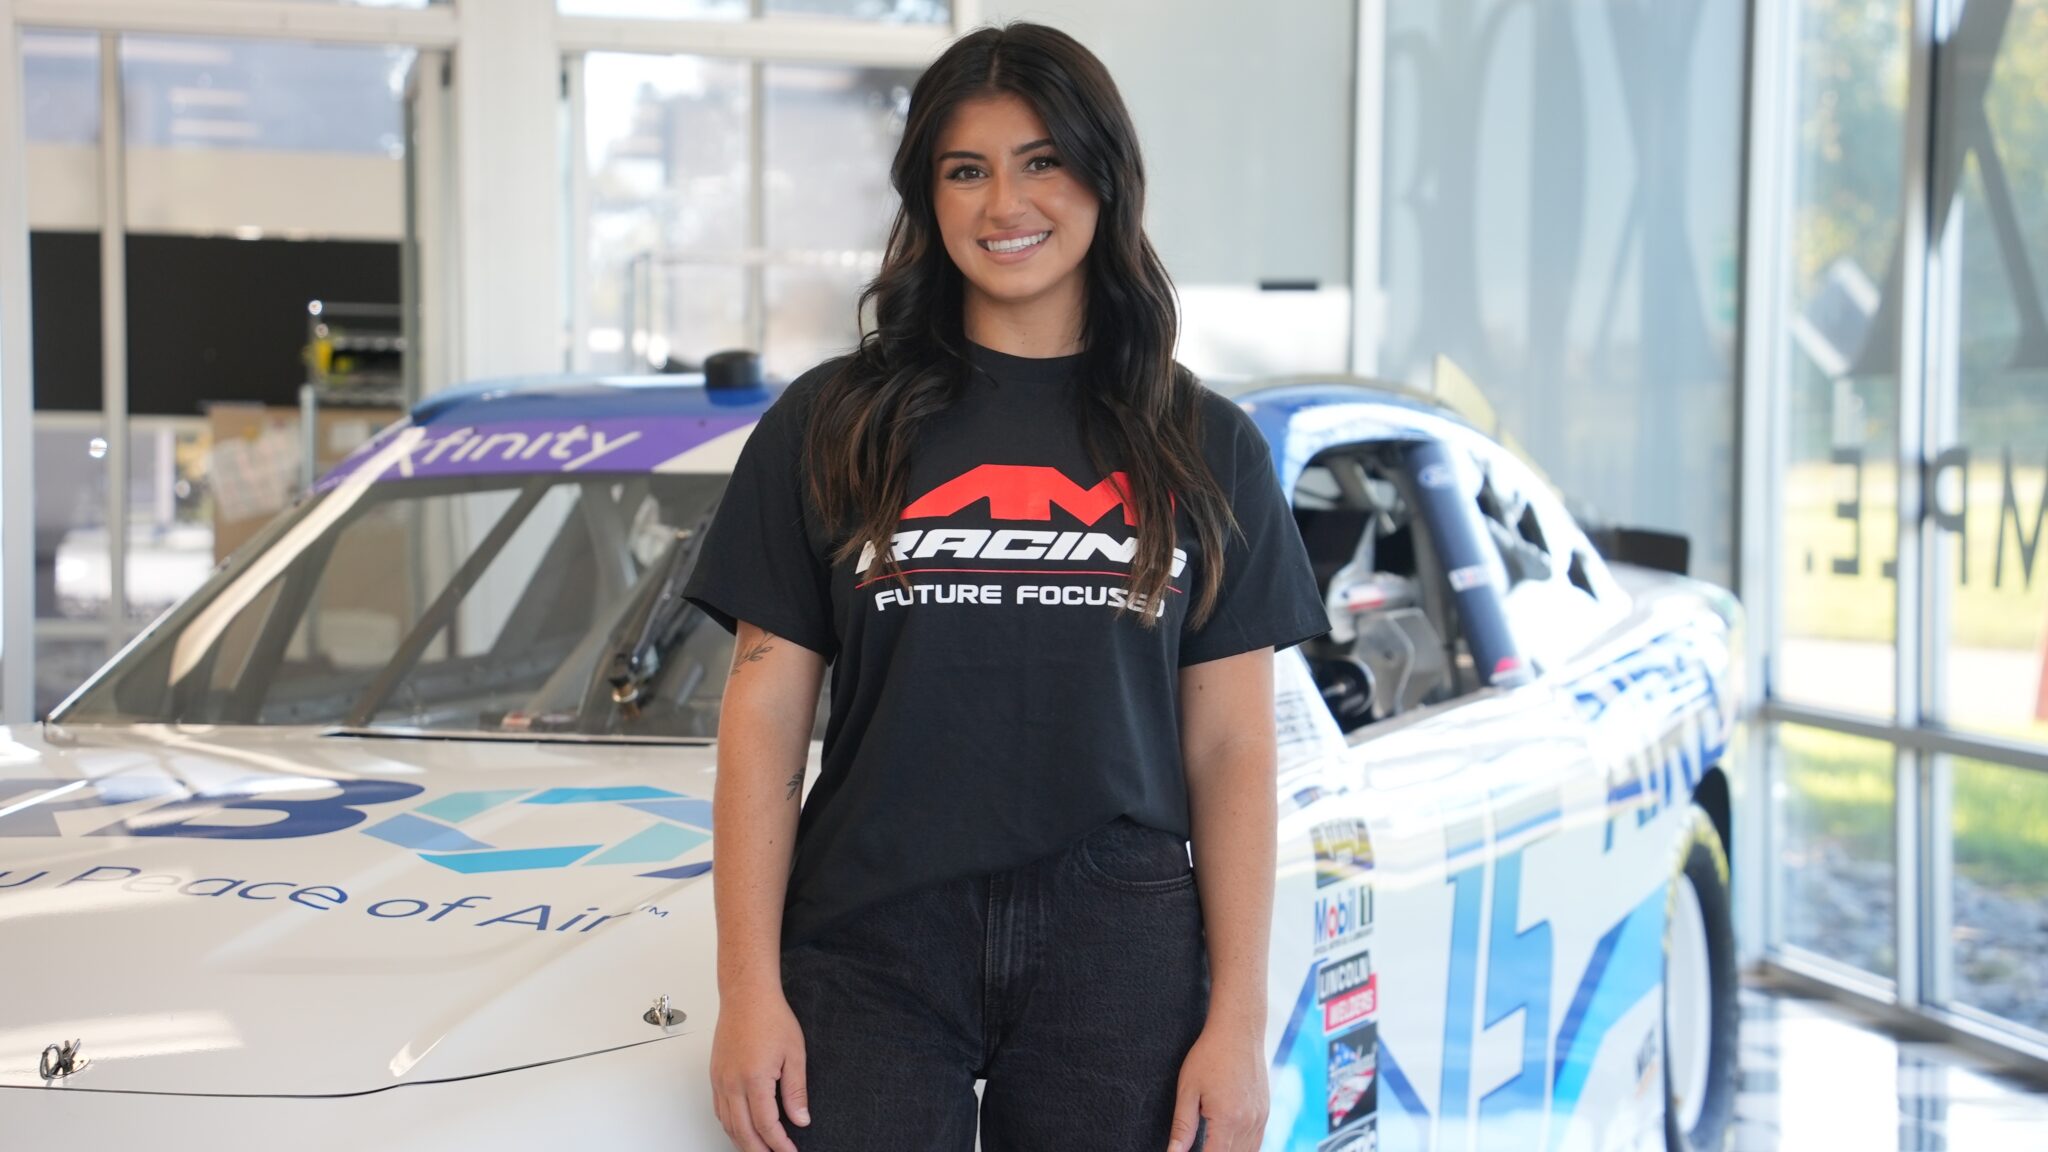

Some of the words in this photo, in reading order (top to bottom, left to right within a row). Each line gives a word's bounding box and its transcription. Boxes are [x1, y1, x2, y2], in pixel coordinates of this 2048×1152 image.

[874, 584, 1003, 612] FUTURE
[54, 865, 349, 910] Peace
[366, 895, 493, 922] of
[1314, 887, 1356, 946] Mobil
